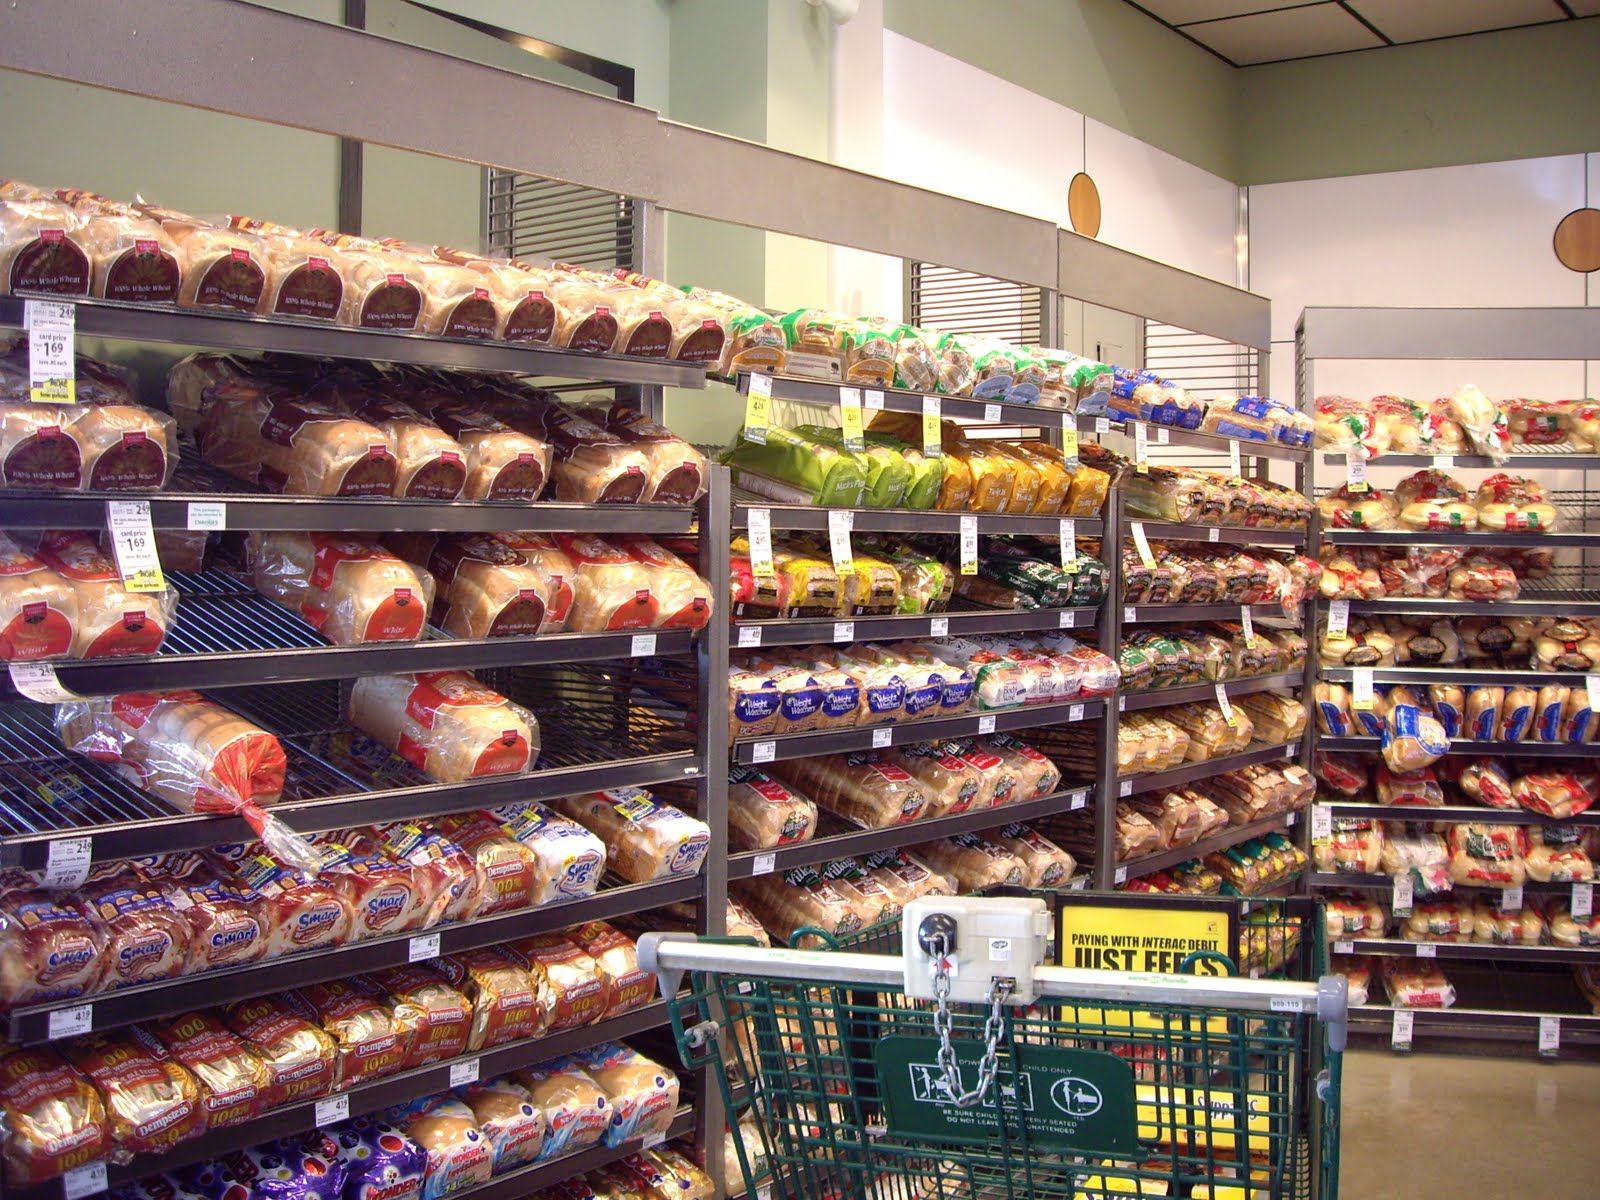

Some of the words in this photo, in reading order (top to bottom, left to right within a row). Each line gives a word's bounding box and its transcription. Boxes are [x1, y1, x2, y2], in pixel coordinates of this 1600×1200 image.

[53, 334, 67, 342] price
[44, 342, 63, 357] 169
[134, 530, 147, 538] price
[126, 538, 145, 551] 169
[748, 699, 768, 708] Weight
[792, 697, 811, 707] Weight
[832, 694, 851, 704] Weight
[877, 693, 897, 702] Weight
[745, 707, 772, 716] Watchers
[791, 705, 816, 715] Watchers
[368, 892, 407, 915] Smart
[300, 908, 341, 929] Smart
[212, 927, 256, 948] Smart
[1072, 934, 1108, 947] PAYING
[1111, 935, 1140, 948] WITH
[1142, 937, 1186, 950] INTERAC
[1188, 939, 1219, 951] DEBIT
[120, 940, 168, 962] Smart
[49, 948, 94, 969] Smart
[75, 1011, 91, 1022] 419
[430, 1010, 463, 1021] Dempster's
[279, 1062, 323, 1084] Dempster's
[1022, 1064, 1048, 1073] CHILD
[1050, 1067, 1073, 1075] ONLY
[210, 1087, 256, 1108] Dempster's
[140, 1105, 190, 1136] Dempster's
[959, 1117, 975, 1125] NOT
[977, 1119, 999, 1127] LEAVE
[1026, 1124, 1075, 1135] UNATTENDED
[1049, 1118, 1077, 1128] SEATED
[50, 1126, 98, 1152] Dempster's
[447, 1156, 489, 1180] Invisibles
